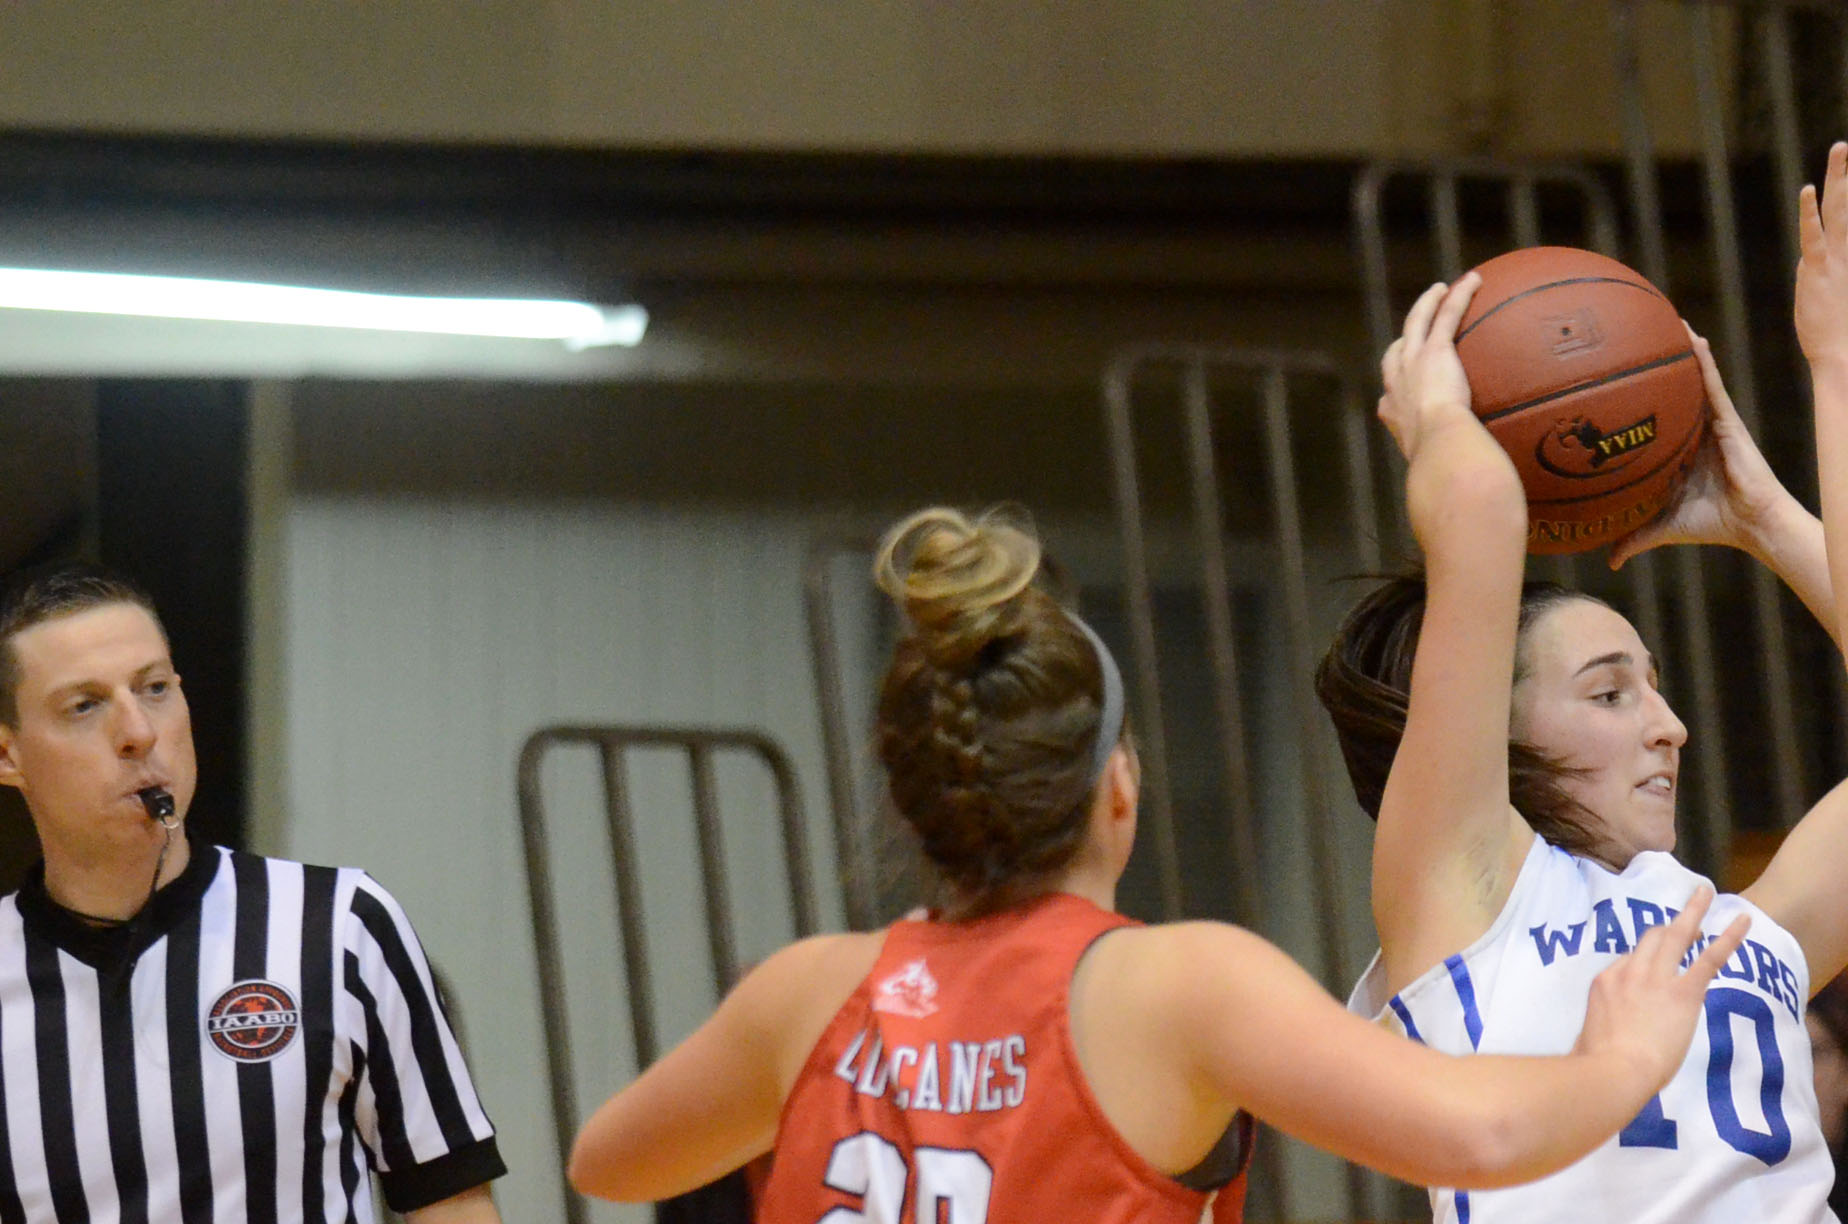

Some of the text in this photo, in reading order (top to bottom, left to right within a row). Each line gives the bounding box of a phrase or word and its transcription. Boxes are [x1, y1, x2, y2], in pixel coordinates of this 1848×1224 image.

[1598, 421, 1654, 455] MIAA
[1528, 896, 1800, 1025] WARORS
[213, 1012, 296, 1030] IAABO
